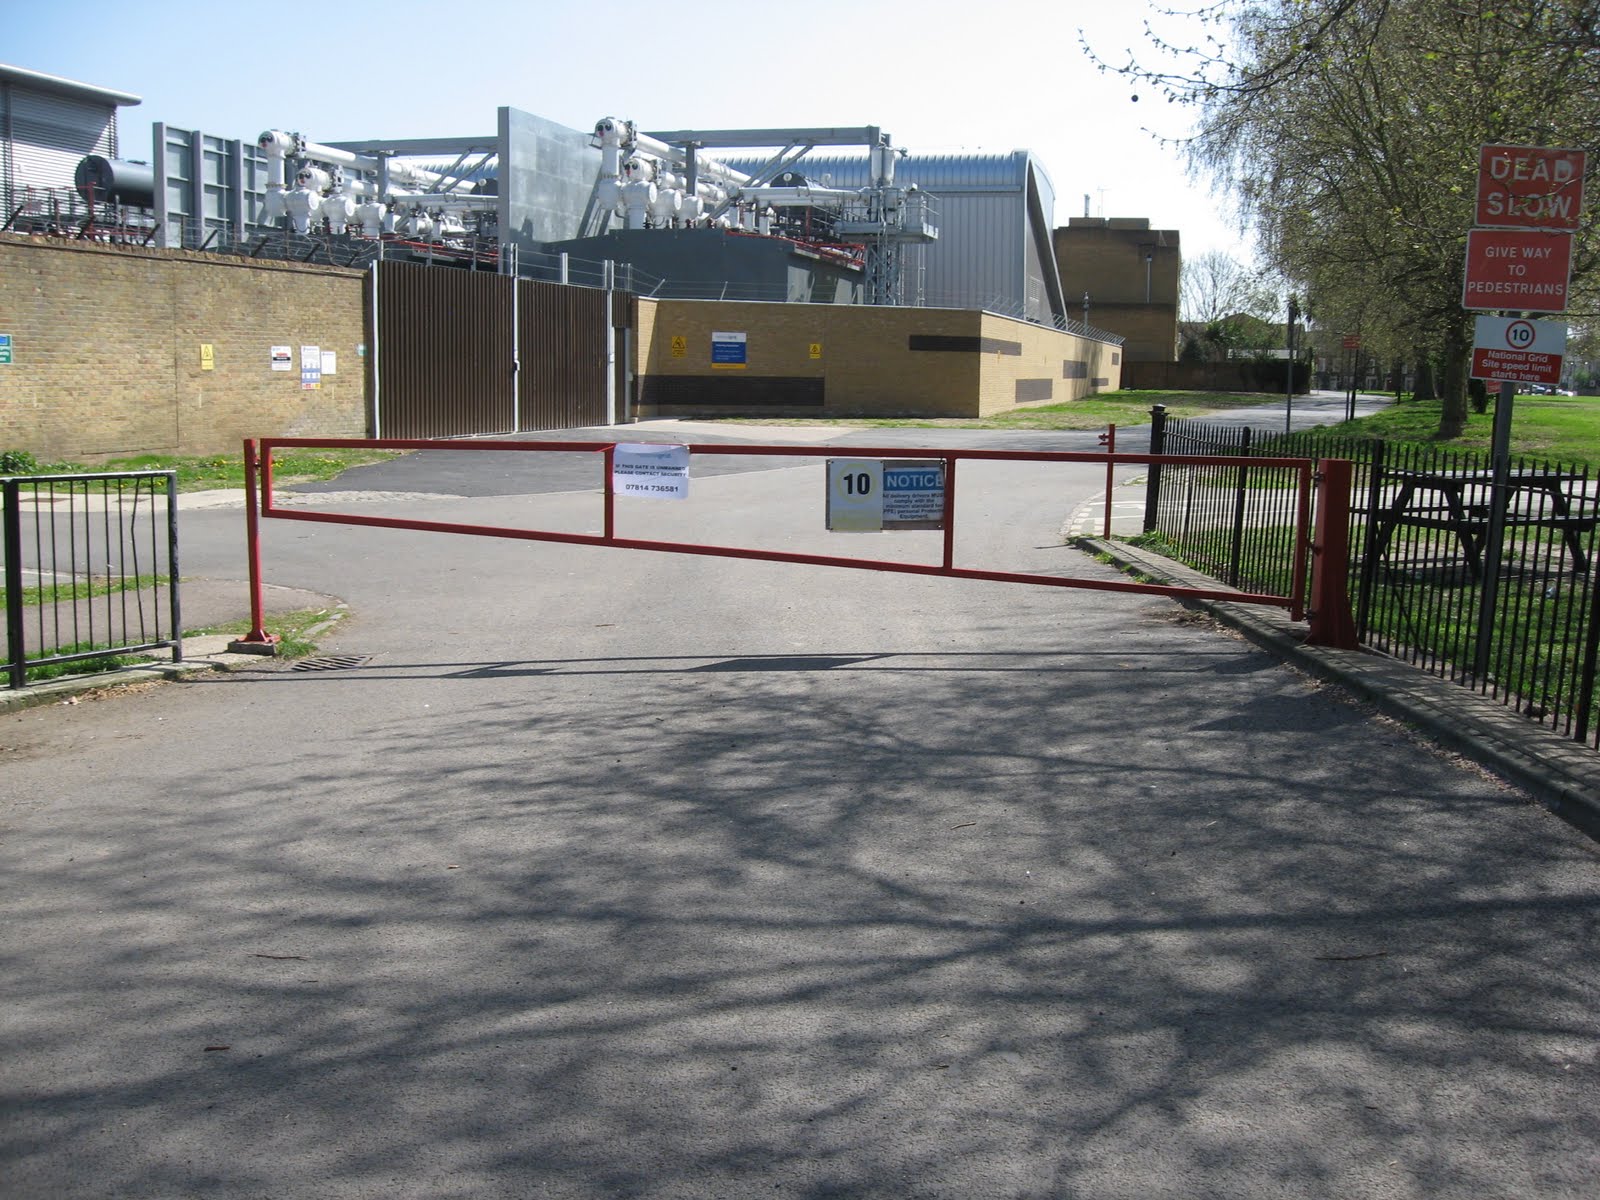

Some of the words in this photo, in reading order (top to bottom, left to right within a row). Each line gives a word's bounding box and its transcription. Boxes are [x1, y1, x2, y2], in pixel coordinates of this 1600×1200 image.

[1490, 156, 1573, 182] DEAD
[1487, 192, 1572, 218] SLOW
[1485, 246, 1517, 258] GIVE
[1522, 247, 1552, 259] WAY
[1508, 264, 1526, 276] TO
[1468, 281, 1563, 295] PEDESTRIANS
[1512, 328, 1530, 342] 10
[1487, 350, 1525, 361] National
[1528, 353, 1548, 363] Grid
[1481, 359, 1500, 368] Site
[1502, 362, 1530, 371] speed
[1531, 364, 1552, 373] limit
[1490, 370, 1517, 380] starts
[1519, 372, 1541, 381] here
[843, 473, 871, 495] 10
[886, 474, 944, 488] NOTICE
